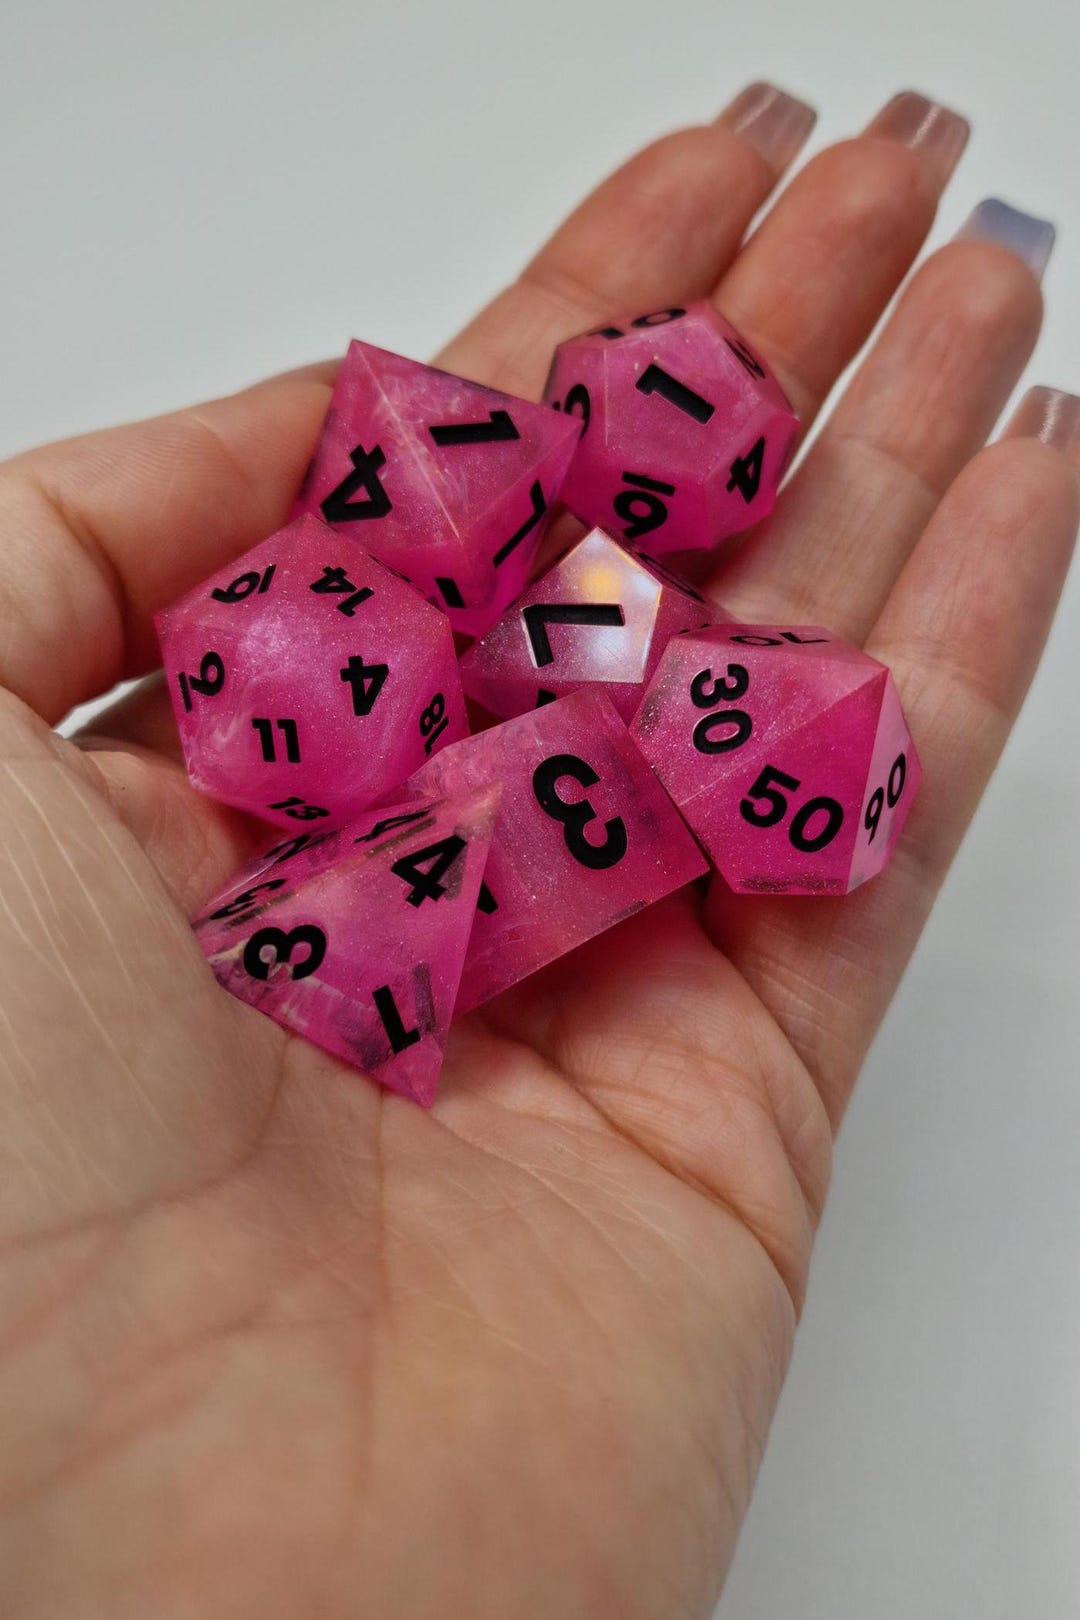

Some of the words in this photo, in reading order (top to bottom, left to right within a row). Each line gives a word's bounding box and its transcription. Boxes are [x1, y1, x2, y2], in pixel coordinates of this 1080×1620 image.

[635, 363, 716, 425] 1
[428, 410, 521, 446] 1
[320, 443, 393, 523] 4
[726, 436, 766, 505] 4
[309, 566, 375, 616] 14
[520, 603, 625, 668] 7
[728, 631, 830, 646] 70
[340, 655, 390, 716] 4
[690, 663, 752, 755] 30
[252, 718, 301, 763] 11
[419, 692, 449, 757] 18
[266, 796, 331, 820] 13
[532, 753, 628, 870] 3
[740, 764, 844, 853] 50
[864, 752, 906, 845] 90
[390, 834, 468, 908] 4
[243, 924, 327, 981] 3
[372, 984, 421, 1054] 1
